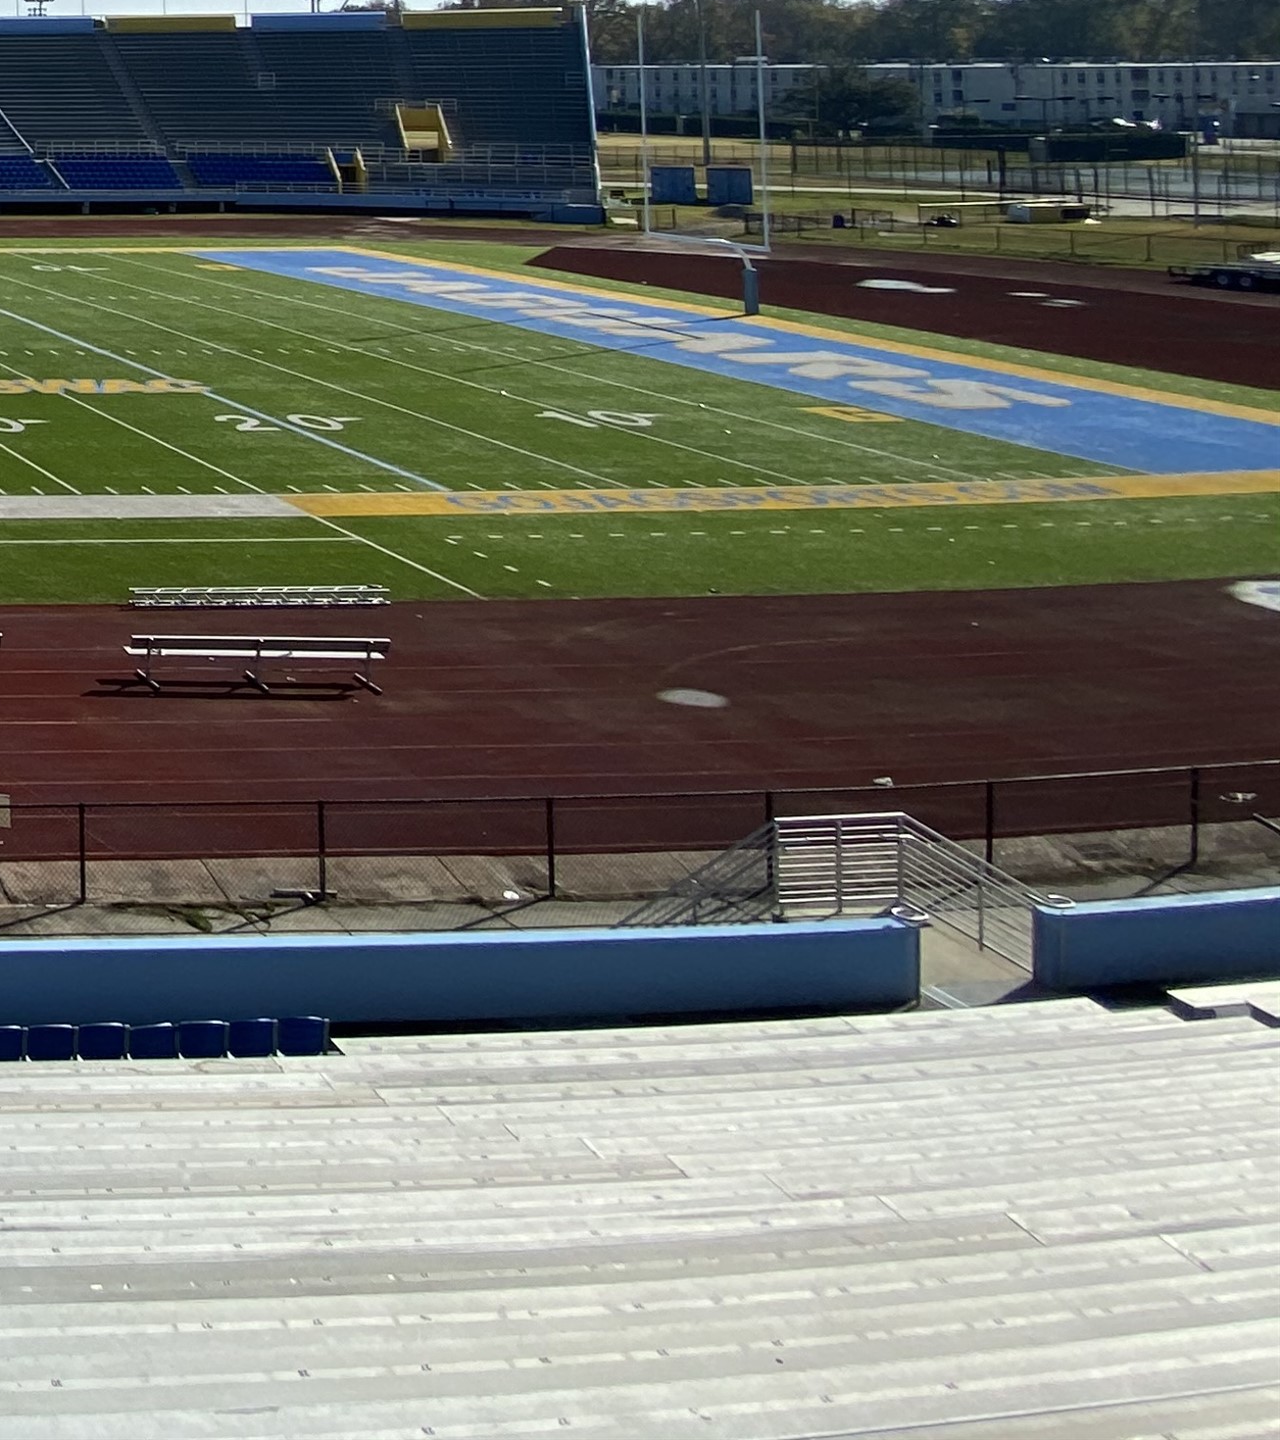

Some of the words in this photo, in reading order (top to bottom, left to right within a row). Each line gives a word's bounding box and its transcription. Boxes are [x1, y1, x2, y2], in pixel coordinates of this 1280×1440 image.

[304, 266, 1073, 410] JAGUARS
[214, 413, 344, 432] 20
[534, 410, 653, 428] 10
